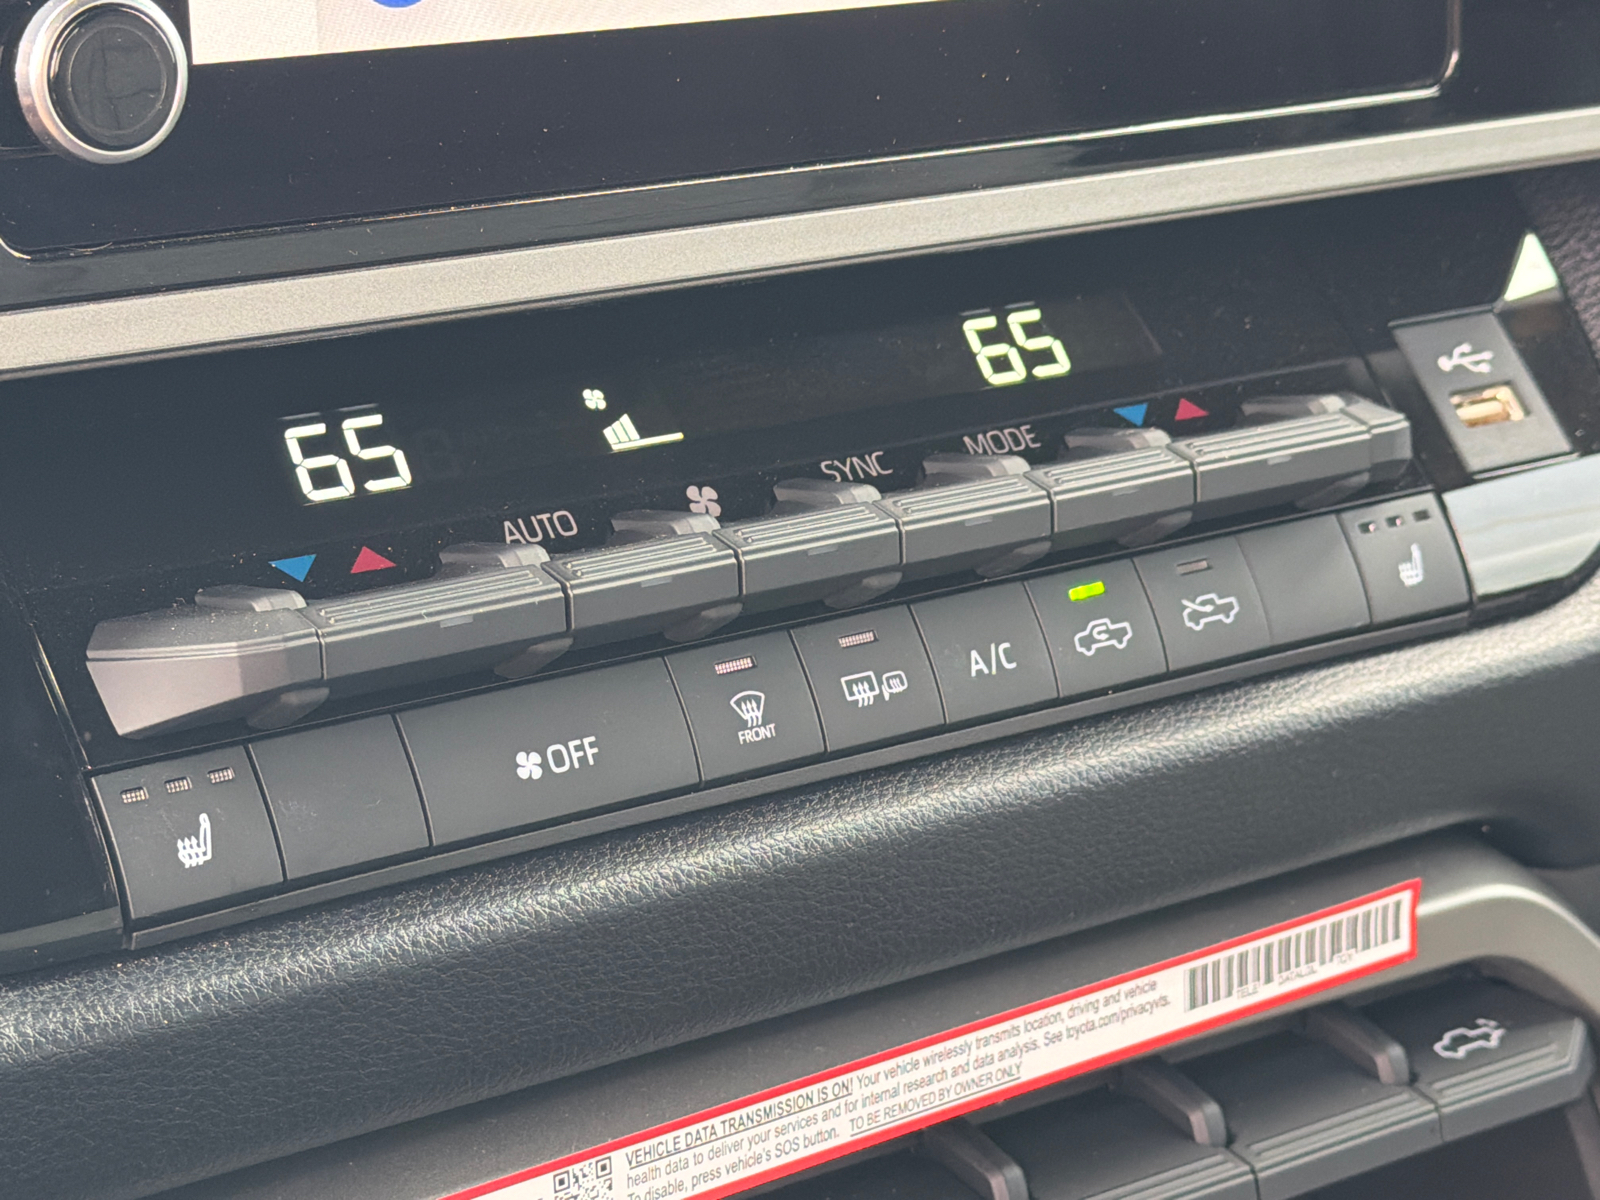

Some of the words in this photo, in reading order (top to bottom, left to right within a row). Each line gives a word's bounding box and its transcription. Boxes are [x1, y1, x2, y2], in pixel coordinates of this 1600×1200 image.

[963, 308, 1071, 386] 65
[284, 414, 412, 501] 65
[820, 451, 893, 483] SYNC
[963, 424, 1042, 456] MODE
[503, 510, 578, 544] AUTO
[970, 642, 1017, 678] A/C
[546, 735, 599, 774] OFF
[737, 723, 776, 745] FRONT
[625, 1135, 681, 1167] VEHICLE
[685, 1123, 718, 1147] DATA
[720, 1090, 814, 1134] TRANSMISSION
[817, 1086, 829, 1102] IS
[832, 1077, 853, 1097] ON!
[857, 1071, 881, 1089] Your
[883, 1057, 920, 1080] vehicle
[922, 1040, 972, 1066] wirelessly
[975, 1024, 1021, 1050] transmits
[1023, 1011, 1064, 1034] location,
[1067, 998, 1099, 1019] driving
[1102, 989, 1121, 1007] and
[1123, 979, 1157, 999] vehicle
[849, 1115, 864, 1131] TO
[867, 1110, 881, 1126] BE
[884, 1091, 936, 1120] REMOVED
[938, 1085, 952, 1102] BY
[954, 1071, 993, 1096] OWNER
[995, 1061, 1022, 1081] ONLY
[627, 1165, 661, 1189] health
[665, 1156, 689, 1175] data
[693, 1151, 704, 1166] to
[707, 1137, 744, 1161] deliver
[747, 1128, 771, 1151] your
[774, 1112, 818, 1138] services
[821, 1102, 841, 1122] and
[844, 1098, 859, 1114] for
[861, 1081, 900, 1108] internal
[903, 1067, 948, 1094] research
[951, 1058, 970, 1078] and
[973, 1052, 995, 1071] data
[997, 1037, 1041, 1062] analysis.
[1043, 1030, 1063, 1047] See
[644, 1178, 688, 1200] disable,
[691, 1166, 721, 1191] press
[725, 1148, 771, 1175] vehicle's
[775, 1138, 800, 1158] SOS
[803, 1127, 839, 1149] button.
